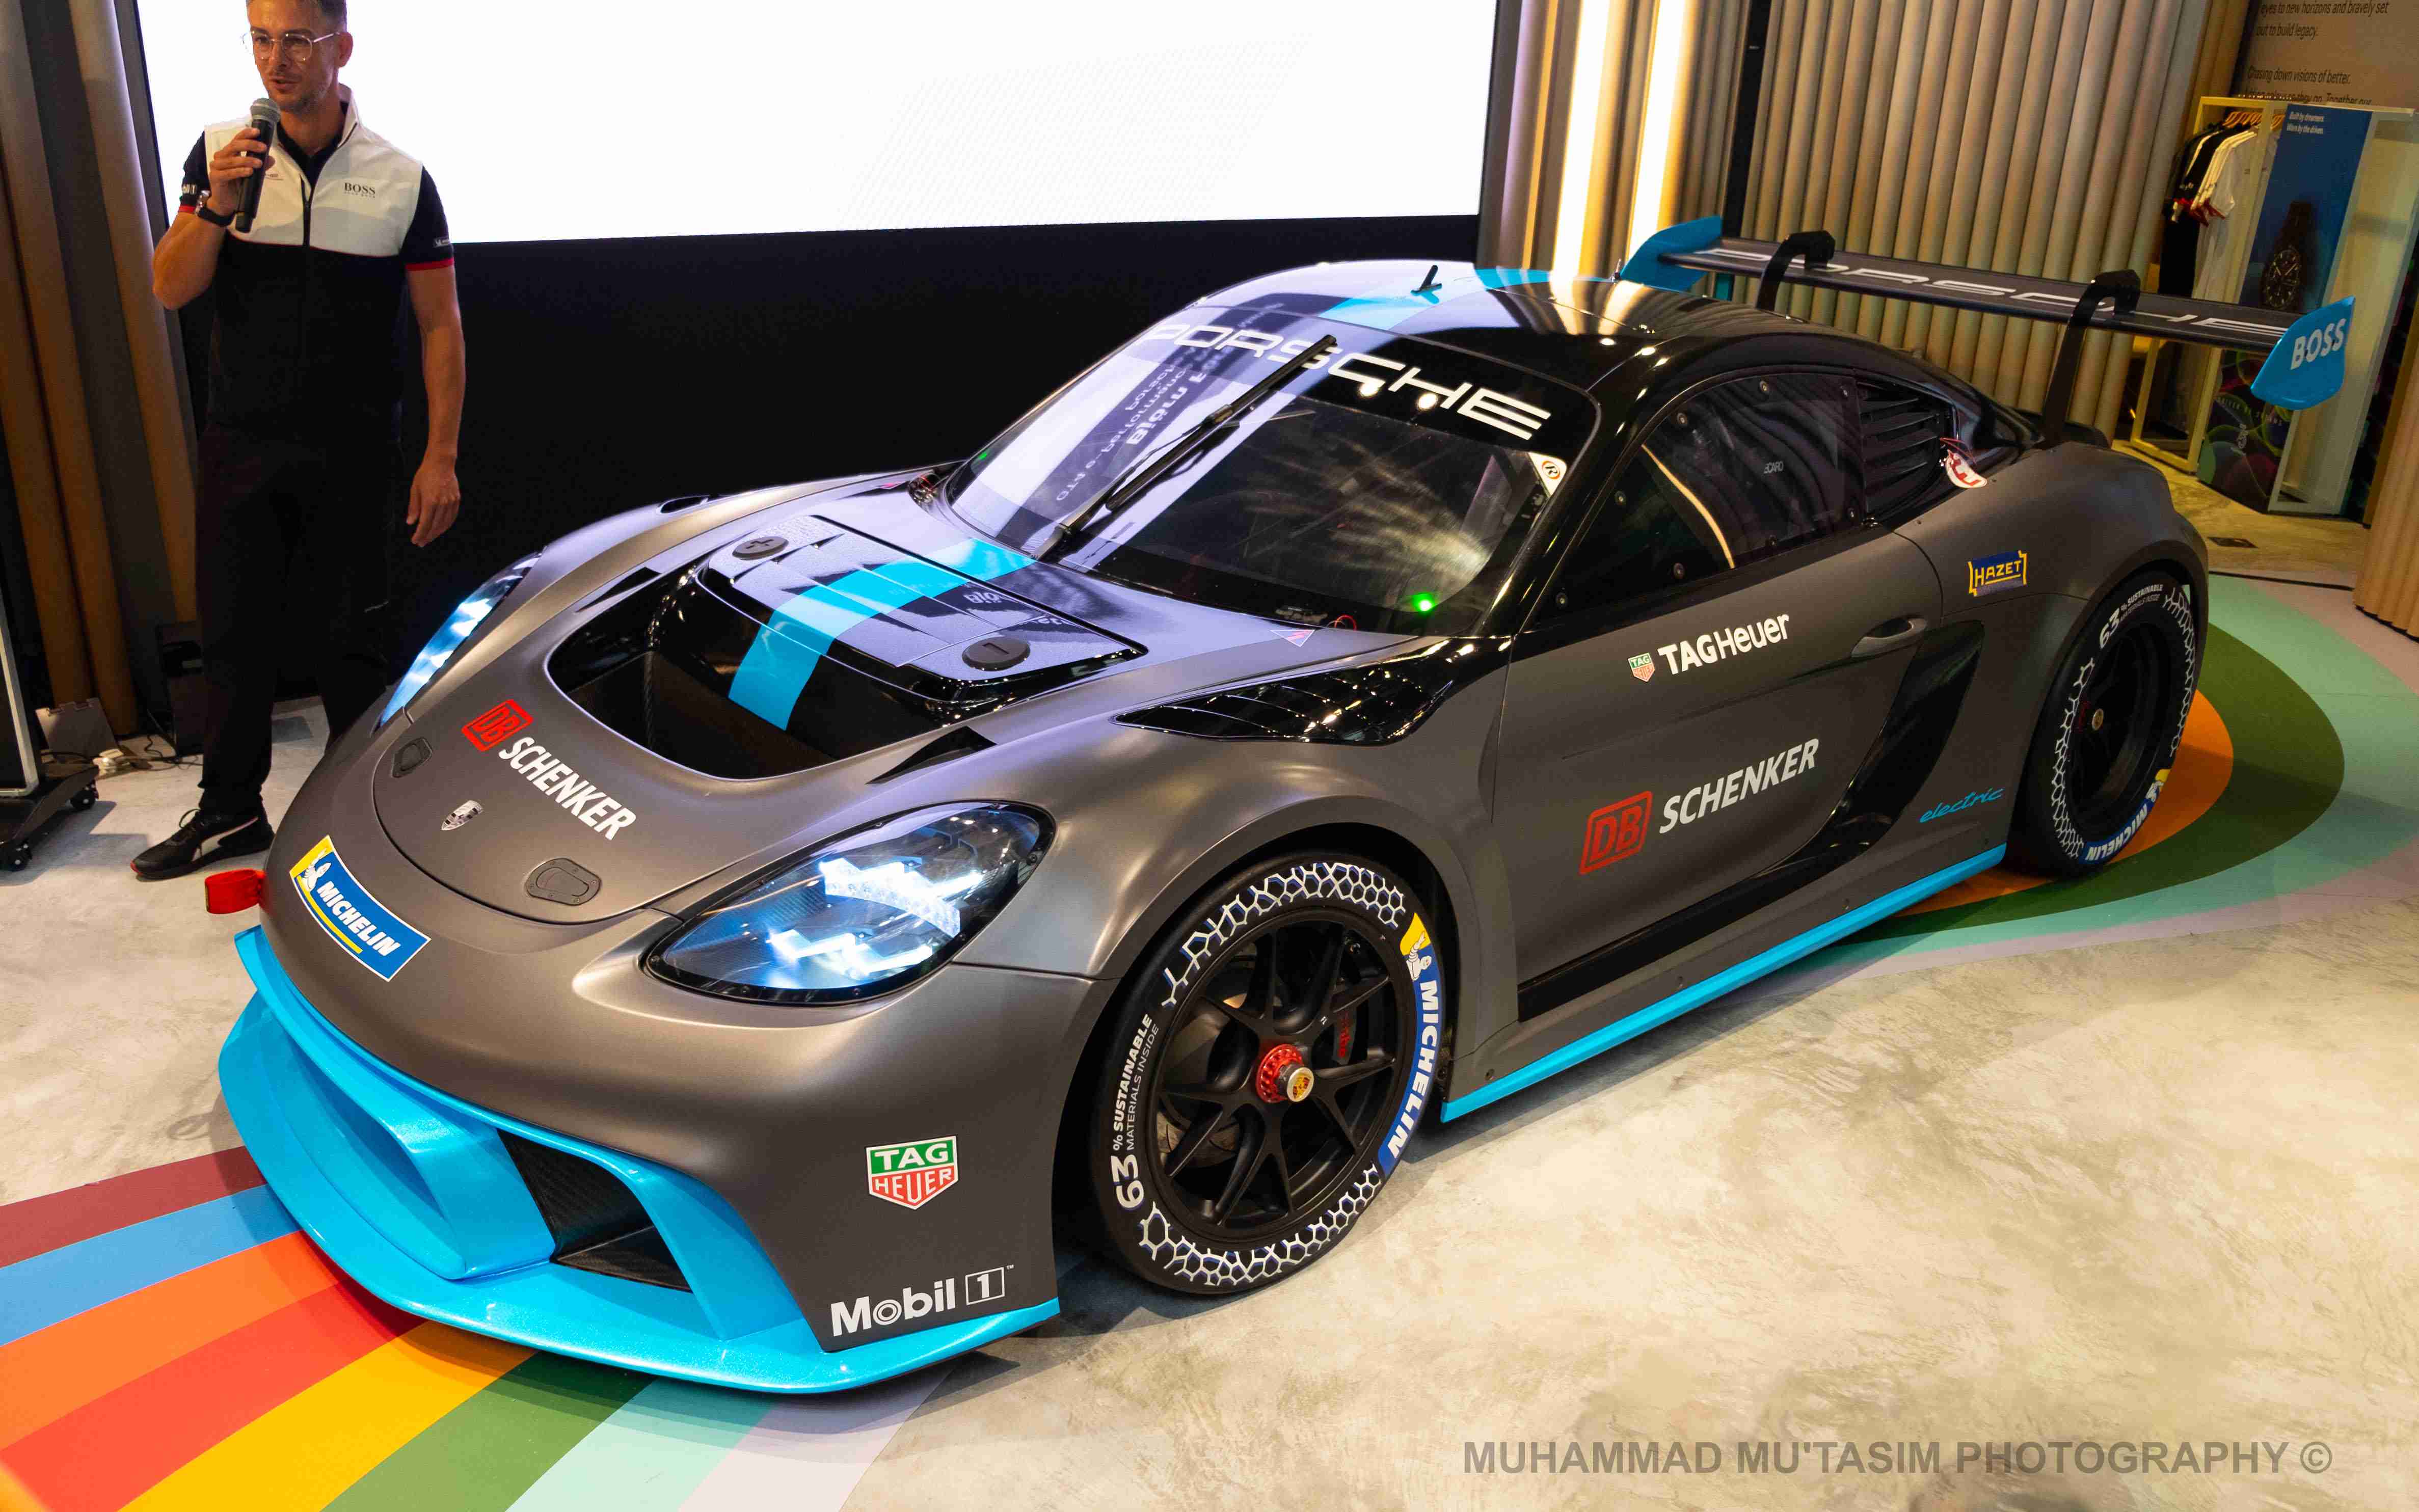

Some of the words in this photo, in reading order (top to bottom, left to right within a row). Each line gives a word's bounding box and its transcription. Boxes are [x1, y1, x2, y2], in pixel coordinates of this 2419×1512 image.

[2278, 2, 2285, 13] to
[2286, 4, 2299, 13] new
[2301, 0, 2331, 14] horizons
[2332, 0, 2347, 14] and
[2347, 0, 2375, 18] bravely
[2376, 2, 2389, 14] set
[2274, 67, 2293, 82] down
[2318, 69, 2327, 83] of
[344, 182, 375, 195] BOSS
[2290, 318, 2347, 370] BOSS
[1136, 324, 1552, 440] PORSCHE
[1973, 558, 2023, 587] HAZET
[2100, 608, 2120, 648] 63
[1630, 655, 1651, 667] TAG
[471, 704, 525, 746] DB
[498, 736, 636, 840] SCHENKER
[1658, 738, 1820, 834] SCHENKER
[1919, 787, 2005, 823] electric
[1587, 802, 1645, 866] DB
[2084, 803, 2148, 861] MICHELIN
[317, 880, 401, 957] MICHELIN
[1113, 1013, 1153, 1131] SUSTAINABLE
[1126, 1075, 1142, 1151] MATERIALS
[1140, 1025, 1160, 1073] INSIDE
[1387, 980, 1439, 1159] MICHELIN
[874, 1143, 949, 1171] TAG
[1113, 1133, 1123, 1151] %
[874, 1168, 952, 1204] HEUER
[1111, 1154, 1145, 1209] 63
[830, 1277, 956, 1337] Mobil
